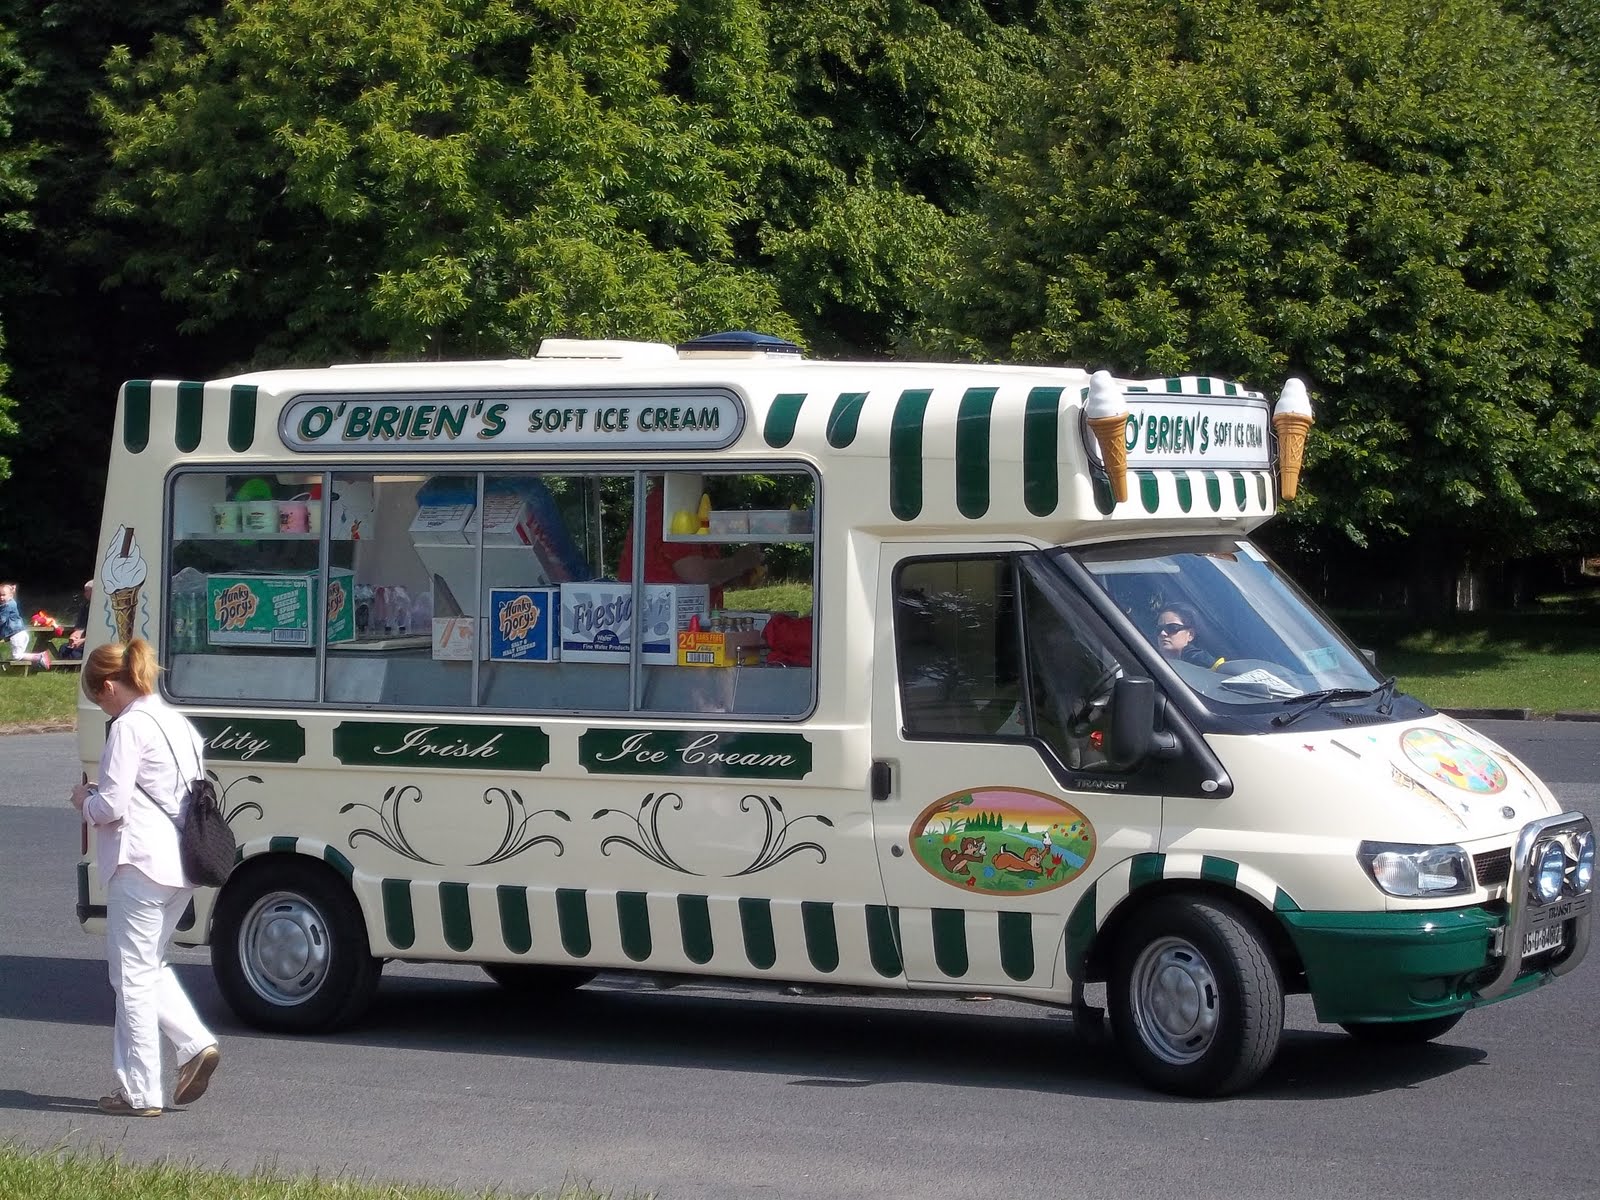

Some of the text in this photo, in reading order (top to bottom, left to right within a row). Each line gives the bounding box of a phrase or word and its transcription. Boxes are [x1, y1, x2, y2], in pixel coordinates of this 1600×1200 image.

[301, 399, 720, 440] O'BRIEN'S SOFT ICE CREAM
[1125, 410, 1263, 454] O'BRIEN'S SOFT ICE CREAM
[220, 586, 249, 606] Hunky
[504, 600, 532, 618] Hunky
[220, 599, 253, 629] Dorys
[504, 612, 534, 640] Dorys
[572, 595, 632, 635] Fiesta
[679, 632, 695, 649] 24
[203, 725, 796, 767] lity Irish Ice Cream
[1074, 779, 1127, 790] TRANSIT
[1548, 902, 1572, 919] TRANSIT
